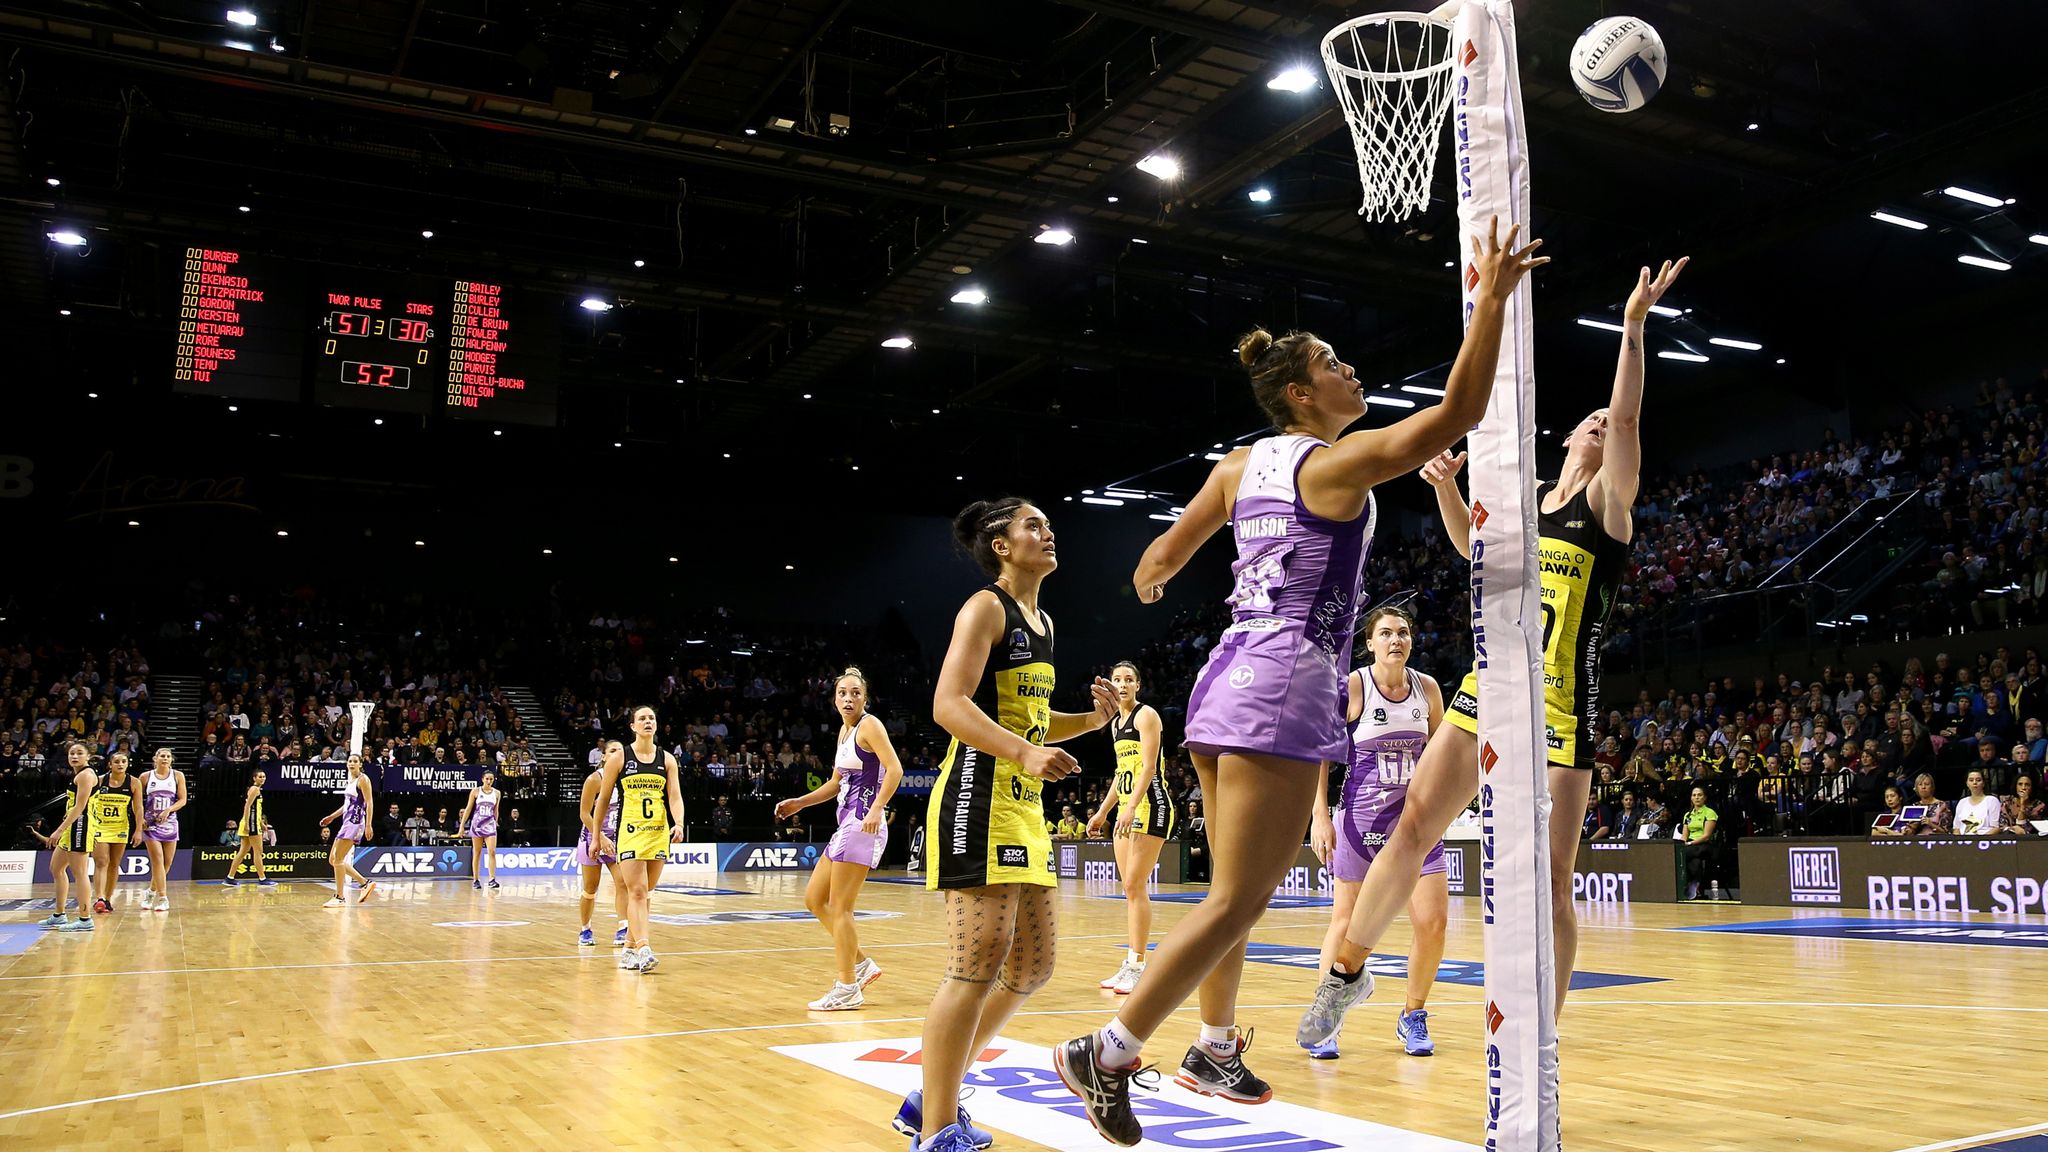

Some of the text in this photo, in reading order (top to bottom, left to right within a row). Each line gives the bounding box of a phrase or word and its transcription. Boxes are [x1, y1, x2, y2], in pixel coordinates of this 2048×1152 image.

[1587, 21, 1637, 70] GILBERT
[187, 248, 238, 262] 00 BURGER
[185, 260, 226, 273] 00 DUNN
[185, 272, 248, 287] 00 EKENASIO
[183, 284, 264, 301] 00 FITZPATRICK
[455, 281, 500, 294] 00 BAILEY
[182, 296, 234, 310] 00 GORDON
[354, 297, 382, 310] PULSE
[454, 292, 500, 306] 00 BURLEY
[181, 308, 239, 322] 00 KERSTEN
[407, 304, 433, 316] STARS
[453, 304, 499, 317] 00 CULLEN
[180, 321, 243, 337] 00 METUARAU
[339, 315, 368, 334] 51
[374, 320, 384, 335] 3
[399, 320, 426, 342] 30
[453, 315, 508, 330] 00 DE BRUIN
[179, 333, 220, 347] 00 RORE
[452, 326, 497, 340] 00 FOWLER
[451, 337, 507, 352] 00 HALPENNY
[178, 345, 236, 360] 00 SOUNESS
[450, 350, 496, 364] 00 HODGES
[176, 357, 218, 370] 00 TEMU
[449, 361, 495, 375] 00 PURVIS
[175, 369, 210, 382] 00 TUI
[358, 365, 393, 386] 52
[449, 373, 462, 383] 00
[448, 384, 494, 397] 00 WILSON
[448, 395, 478, 408] 00 VUI
[1238, 518, 1288, 539] WILSON
[1538, 551, 1584, 564] ANGA O
[1539, 561, 1582, 579] KAWA
[1540, 586, 1556, 599] ero
[1471, 540, 1488, 670] SUZUKI
[1017, 672, 1029, 682] TE
[281, 765, 346, 779] NOW YOU'RE
[404, 767, 465, 780] NOW YOU'RE
[960, 746, 976, 790] ANANGA
[1378, 751, 1416, 785] GA
[311, 779, 335, 788] GAME
[433, 781, 456, 789] GAME
[103, 807, 119, 817] GA
[642, 798, 653, 819] C
[953, 801, 971, 855] RAUKAWA
[201, 851, 251, 860] brendn
[282, 850, 328, 862] supersite
[665, 853, 709, 865] ZUKI
[745, 848, 798, 867] ANZ
[1480, 784, 1495, 924] SUZUKI
[371, 852, 434, 873] ANZ
[1085, 861, 1118, 882] REBEL
[1794, 853, 1836, 887] REBEL
[1284, 867, 1313, 891] BEL
[1573, 872, 1632, 902] PORT
[1867, 876, 1980, 913] REBEL
[1486, 1044, 1501, 1152] SUZU
